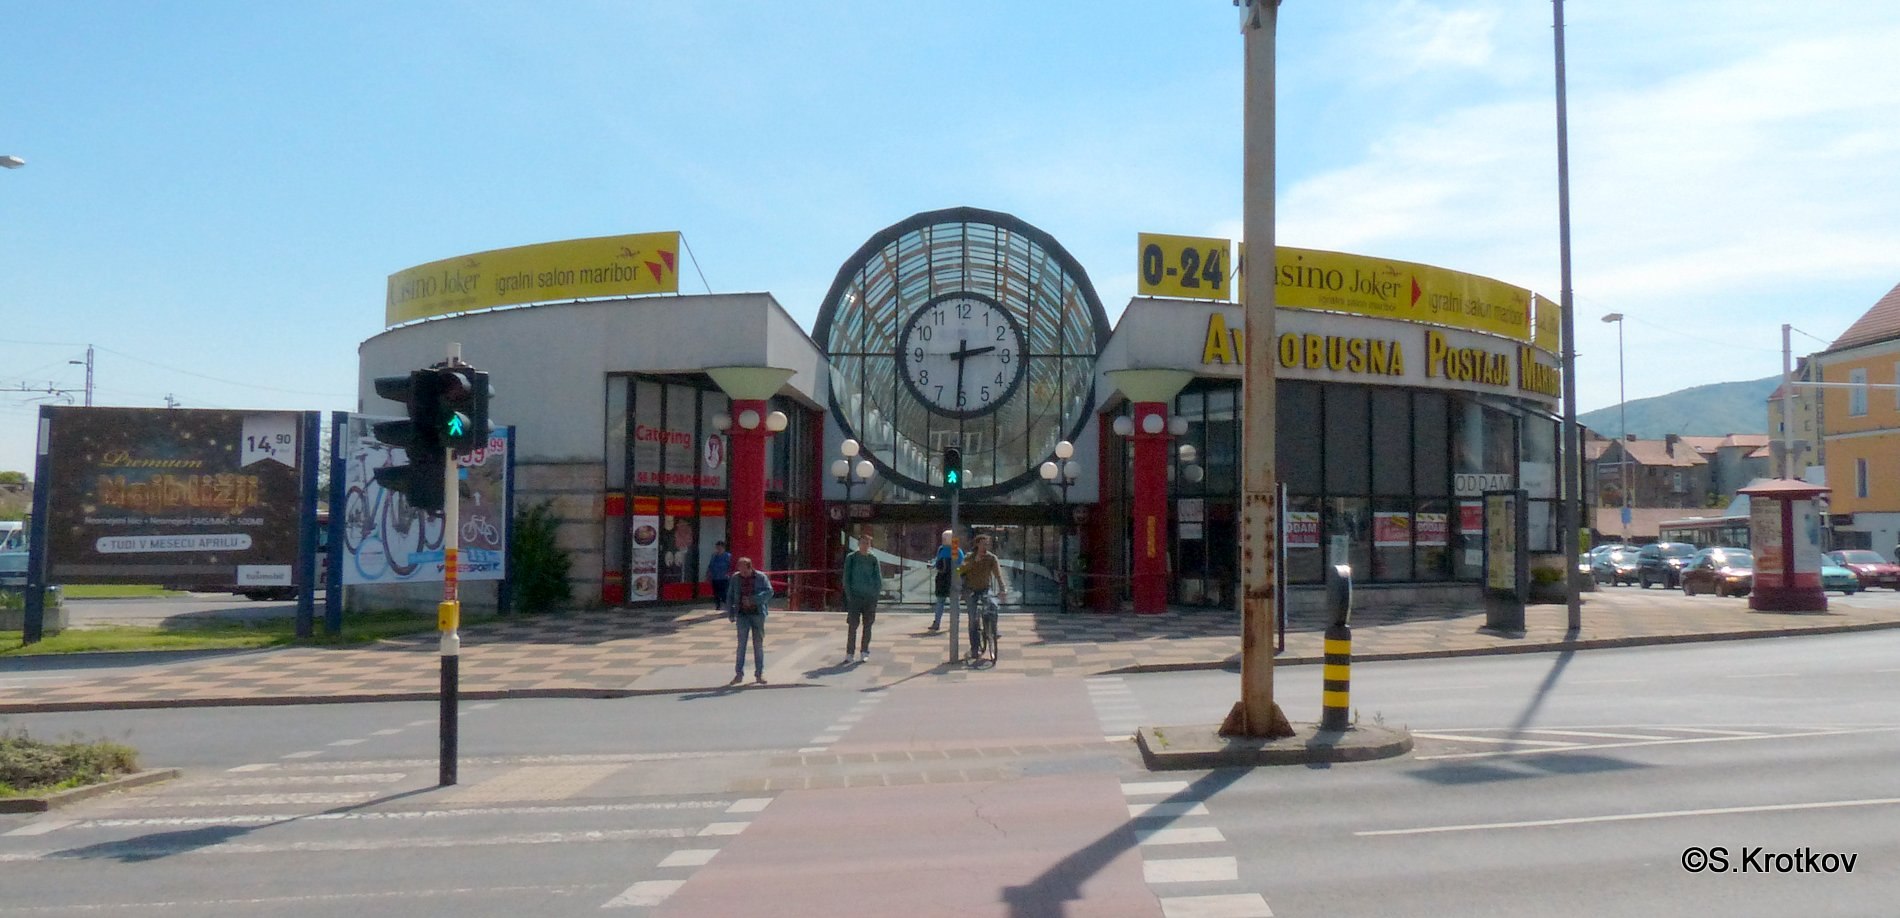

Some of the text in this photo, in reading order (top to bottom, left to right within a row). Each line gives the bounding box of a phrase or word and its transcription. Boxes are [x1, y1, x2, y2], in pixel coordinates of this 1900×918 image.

[1143, 243, 1223, 290] 0-24
[441, 268, 480, 296] Joker
[496, 263, 639, 296] igralni salon maribor
[1239, 254, 1402, 301] sino Joker
[932, 311, 945, 326] 11
[955, 303, 972, 319] 12
[983, 312, 989, 327] 1
[917, 325, 932, 341] 10
[996, 325, 1006, 341] 2
[1203, 312, 1404, 376] AVOBUSNA
[914, 347, 924, 363] 9
[1001, 348, 1011, 364] 3
[919, 370, 929, 385] 8
[994, 372, 1003, 387] 4
[934, 385, 944, 400] 7
[958, 391, 967, 406] 6
[981, 386, 990, 401] 5
[636, 424, 692, 449] Catering
[98, 451, 202, 468] Premium
[1455, 475, 1510, 492] ODDAM
[1286, 522, 1317, 534] DDAM
[110, 536, 239, 550] TUDI V MESECU APRILU
